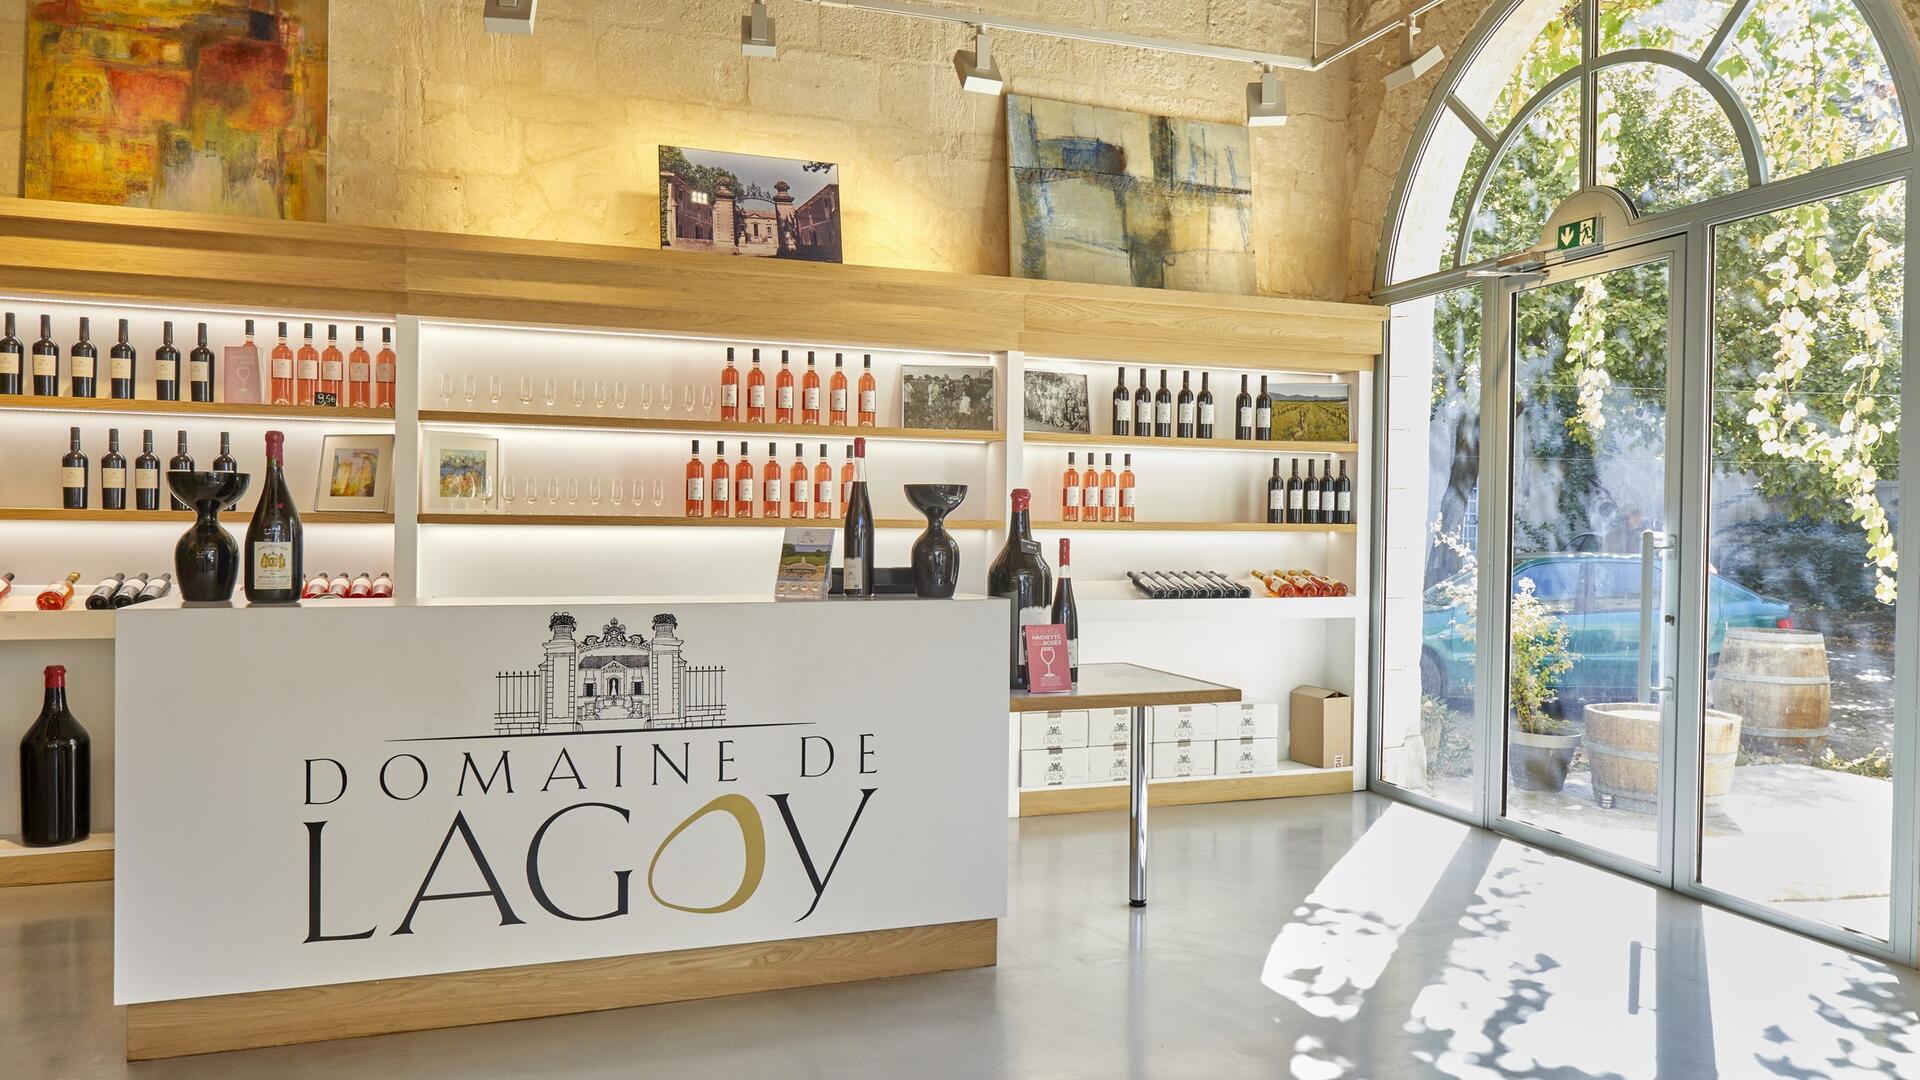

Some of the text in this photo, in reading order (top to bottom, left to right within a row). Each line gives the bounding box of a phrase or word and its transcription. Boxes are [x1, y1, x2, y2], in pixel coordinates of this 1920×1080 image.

[303, 733, 878, 806] DOMAINE DE
[302, 787, 879, 944] LAGOY
